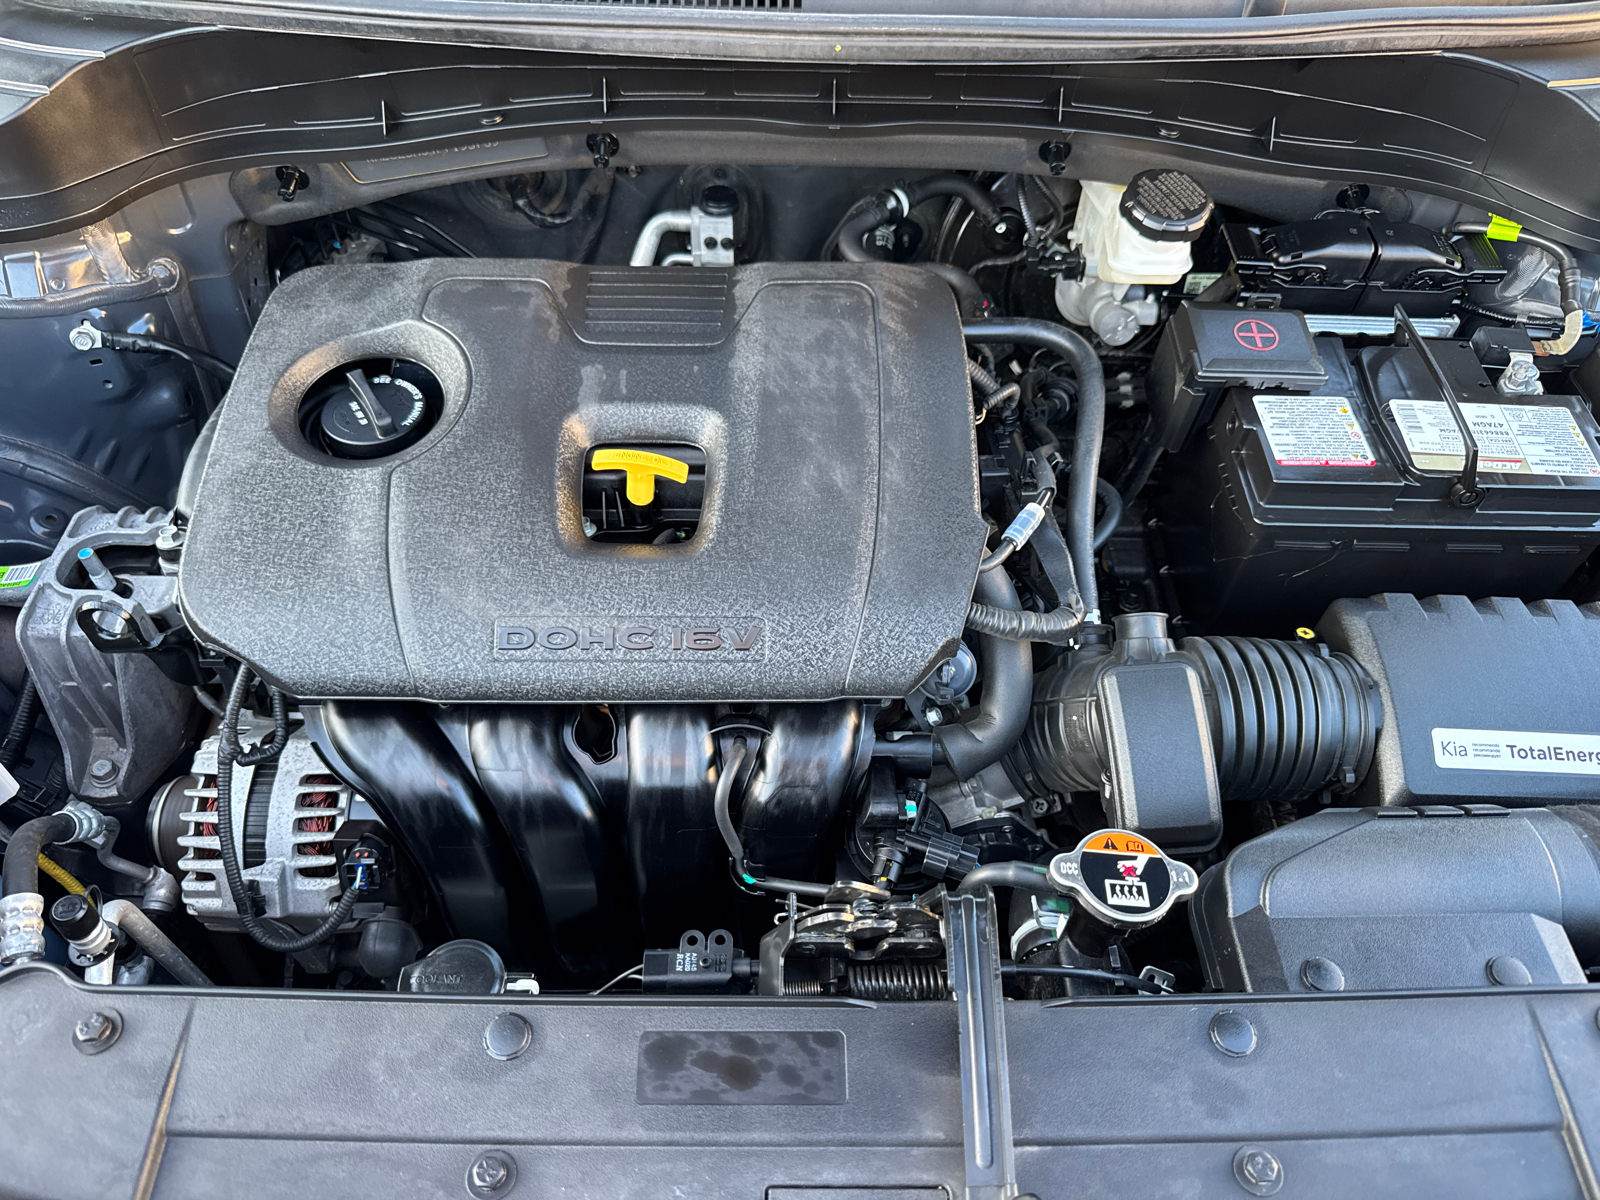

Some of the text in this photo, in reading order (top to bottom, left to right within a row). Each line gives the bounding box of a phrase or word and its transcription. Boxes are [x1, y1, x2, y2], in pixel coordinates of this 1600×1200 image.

[372, 376, 424, 426] SEE OWNER'S MANUAL
[614, 451, 648, 461] ENGINE
[1467, 461, 1520, 470] ACDel
[498, 626, 762, 650] DOHC 16V
[1440, 740, 1468, 757] Kia
[1170, 870, 1190, 884] 1.1
